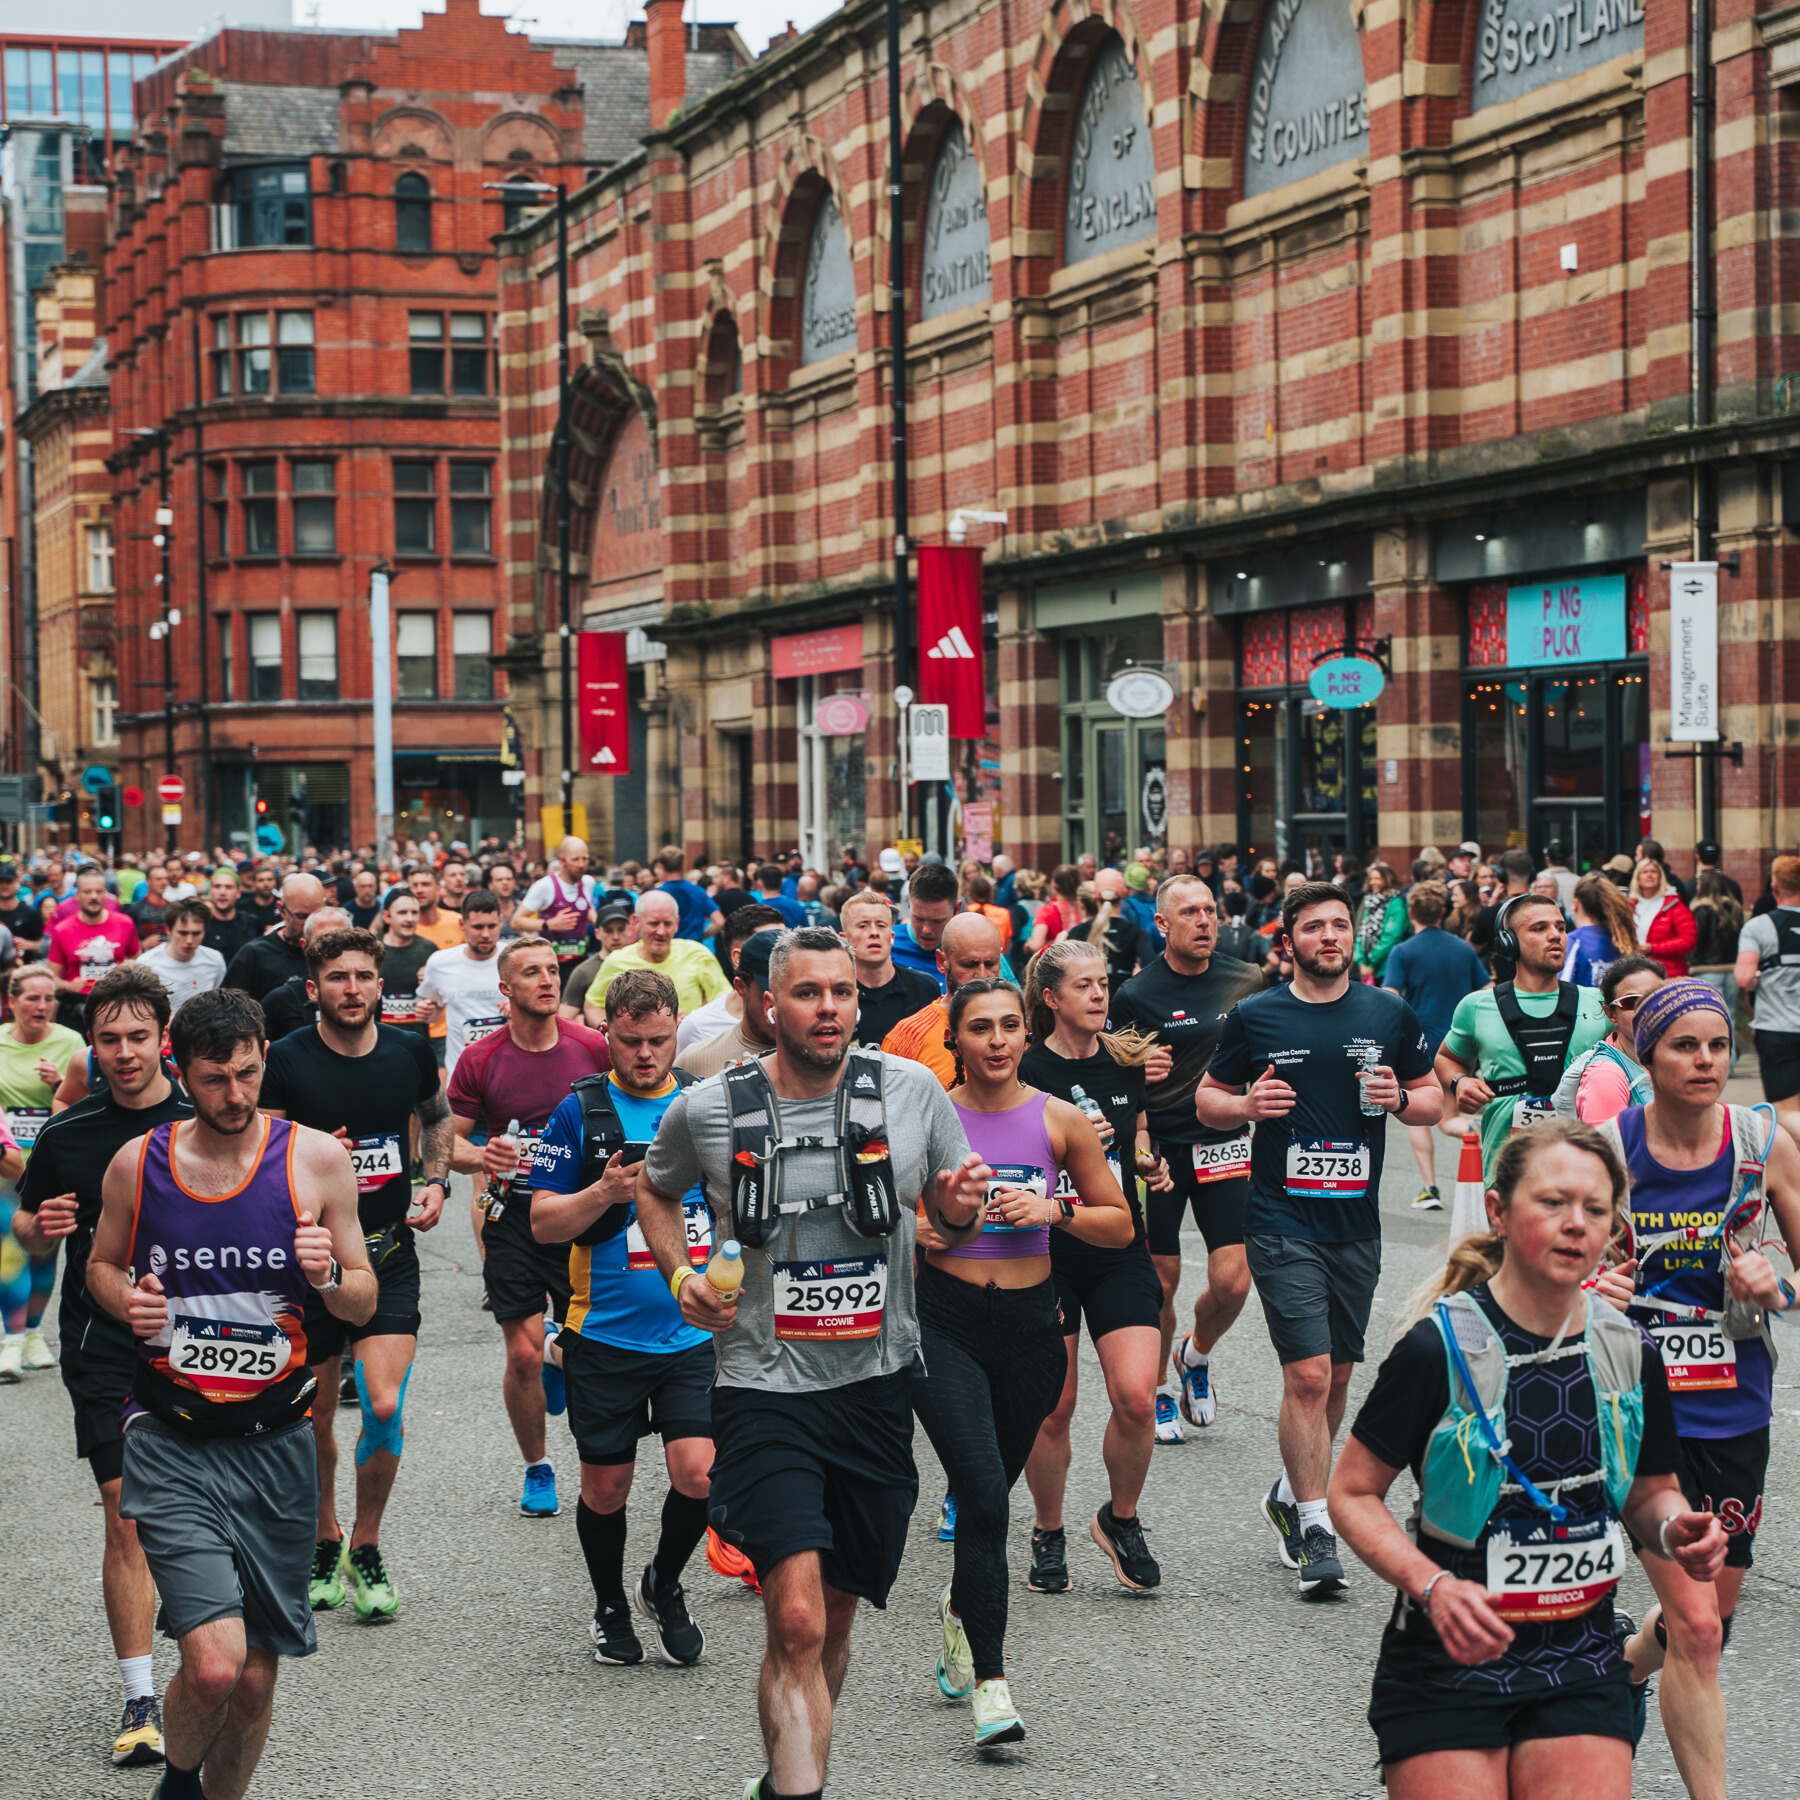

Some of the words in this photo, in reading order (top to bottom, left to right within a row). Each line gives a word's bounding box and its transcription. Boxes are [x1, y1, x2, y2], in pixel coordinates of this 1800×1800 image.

[1271, 91, 1370, 166] COUNTIES
[1111, 126, 1136, 160] OF
[1543, 624, 1581, 657] PUCK
[1680, 616, 1695, 728] Management
[1328, 683, 1361, 696] PUCK
[1695, 682, 1709, 728] Suite
[1351, 1037, 1376, 1045] Waters
[1268, 1050, 1290, 1059] Porsche
[1111, 1094, 1129, 1106] Huel
[537, 1139, 572, 1159] imer's
[1199, 1143, 1249, 1165] 26655
[532, 1153, 557, 1173] iety
[1296, 1156, 1362, 1177] 23738
[866, 1183, 880, 1220] AONIJIE
[174, 1246, 287, 1270] sense
[1664, 1257, 1704, 1270] LISA
[785, 1281, 881, 1312] 25992
[817, 1318, 824, 1327] A
[824, 1316, 855, 1327] COWIE
[180, 1344, 277, 1376] 28925
[1668, 1366, 1689, 1377] LISA
[1504, 1544, 1615, 1585] 27264
[1537, 1590, 1585, 1605] REBECCA
